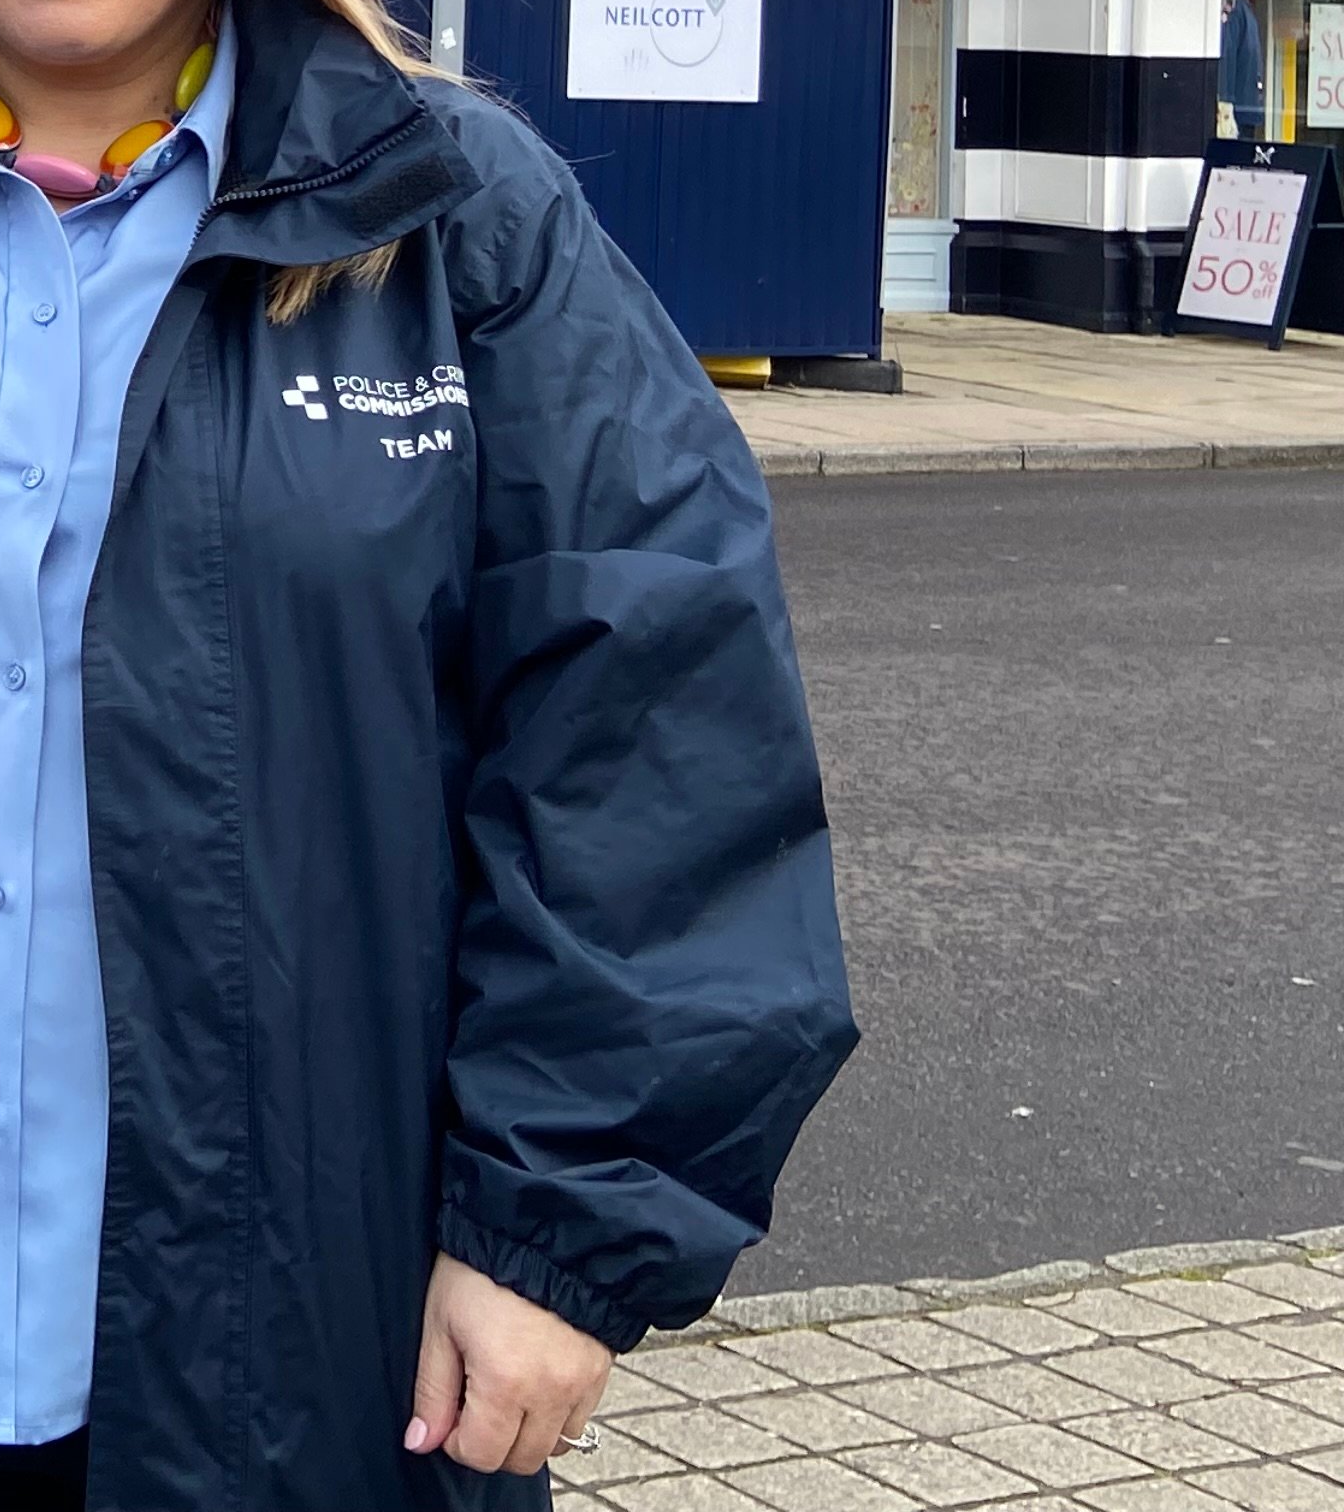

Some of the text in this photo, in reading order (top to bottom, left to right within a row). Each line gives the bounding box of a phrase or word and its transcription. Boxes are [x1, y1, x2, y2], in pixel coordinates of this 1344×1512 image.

[605, 5, 706, 29] NEILCOTT
[1209, 207, 1286, 245] SALE
[333, 375, 411, 399] POLICE
[415, 376, 430, 392] &
[379, 429, 454, 460] TEAM
